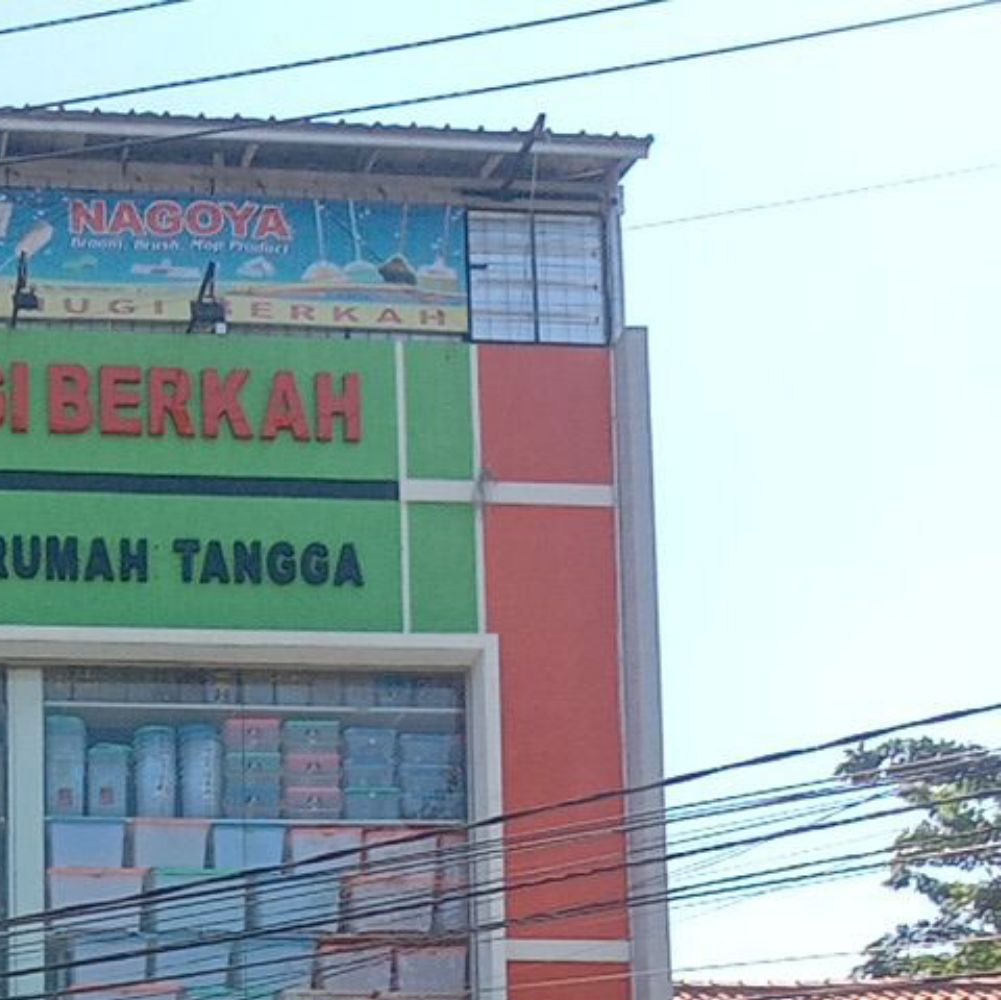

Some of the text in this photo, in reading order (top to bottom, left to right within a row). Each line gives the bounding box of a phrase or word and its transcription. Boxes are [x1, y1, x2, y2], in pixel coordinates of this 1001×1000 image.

[69, 199, 292, 240] NAGOYA
[229, 240, 289, 254] Product
[36, 297, 164, 315] UGI
[46, 365, 362, 442] BERKAH
[173, 539, 364, 587] TANGGA
